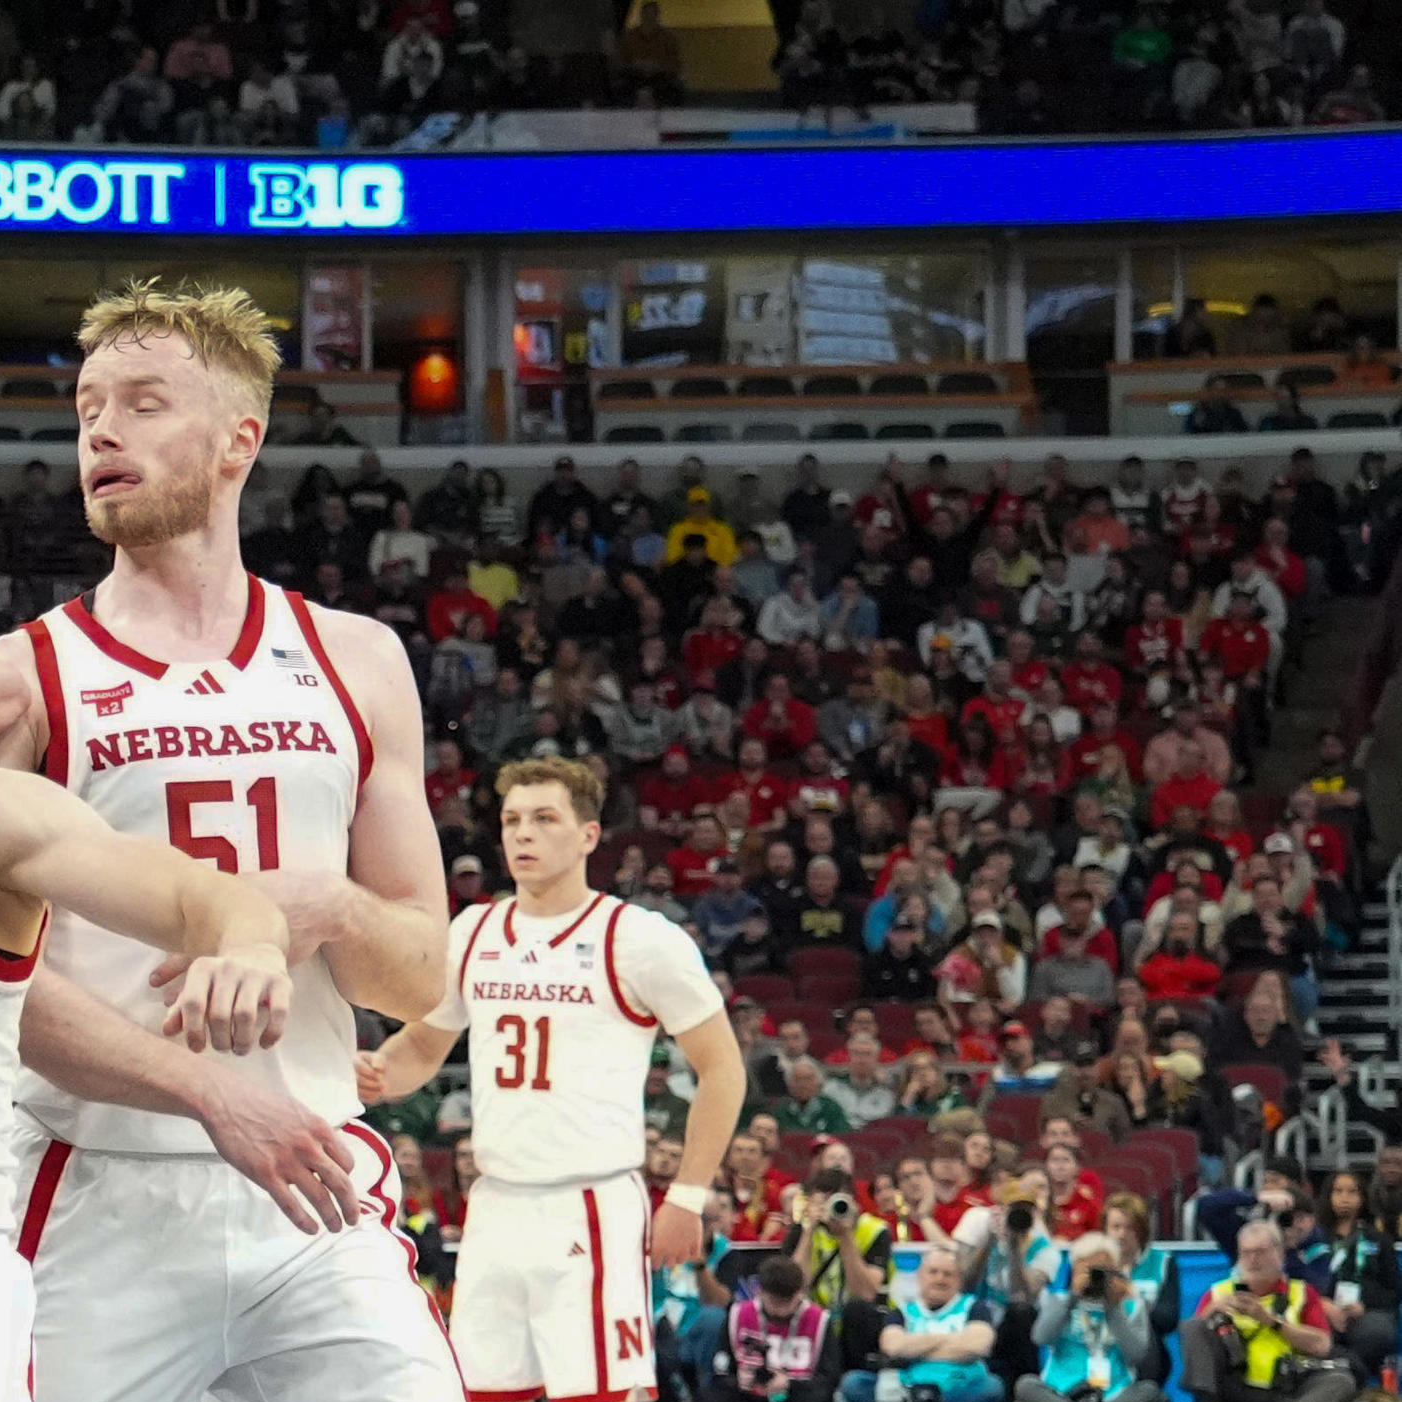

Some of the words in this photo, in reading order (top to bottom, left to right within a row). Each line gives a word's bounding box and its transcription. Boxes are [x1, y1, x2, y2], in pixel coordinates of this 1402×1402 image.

[86, 720, 337, 771] NEBRASKA
[165, 777, 279, 875] 51
[474, 982, 594, 1004] NEBRASKA
[496, 1014, 551, 1091] 31
[615, 1316, 644, 1361] N
